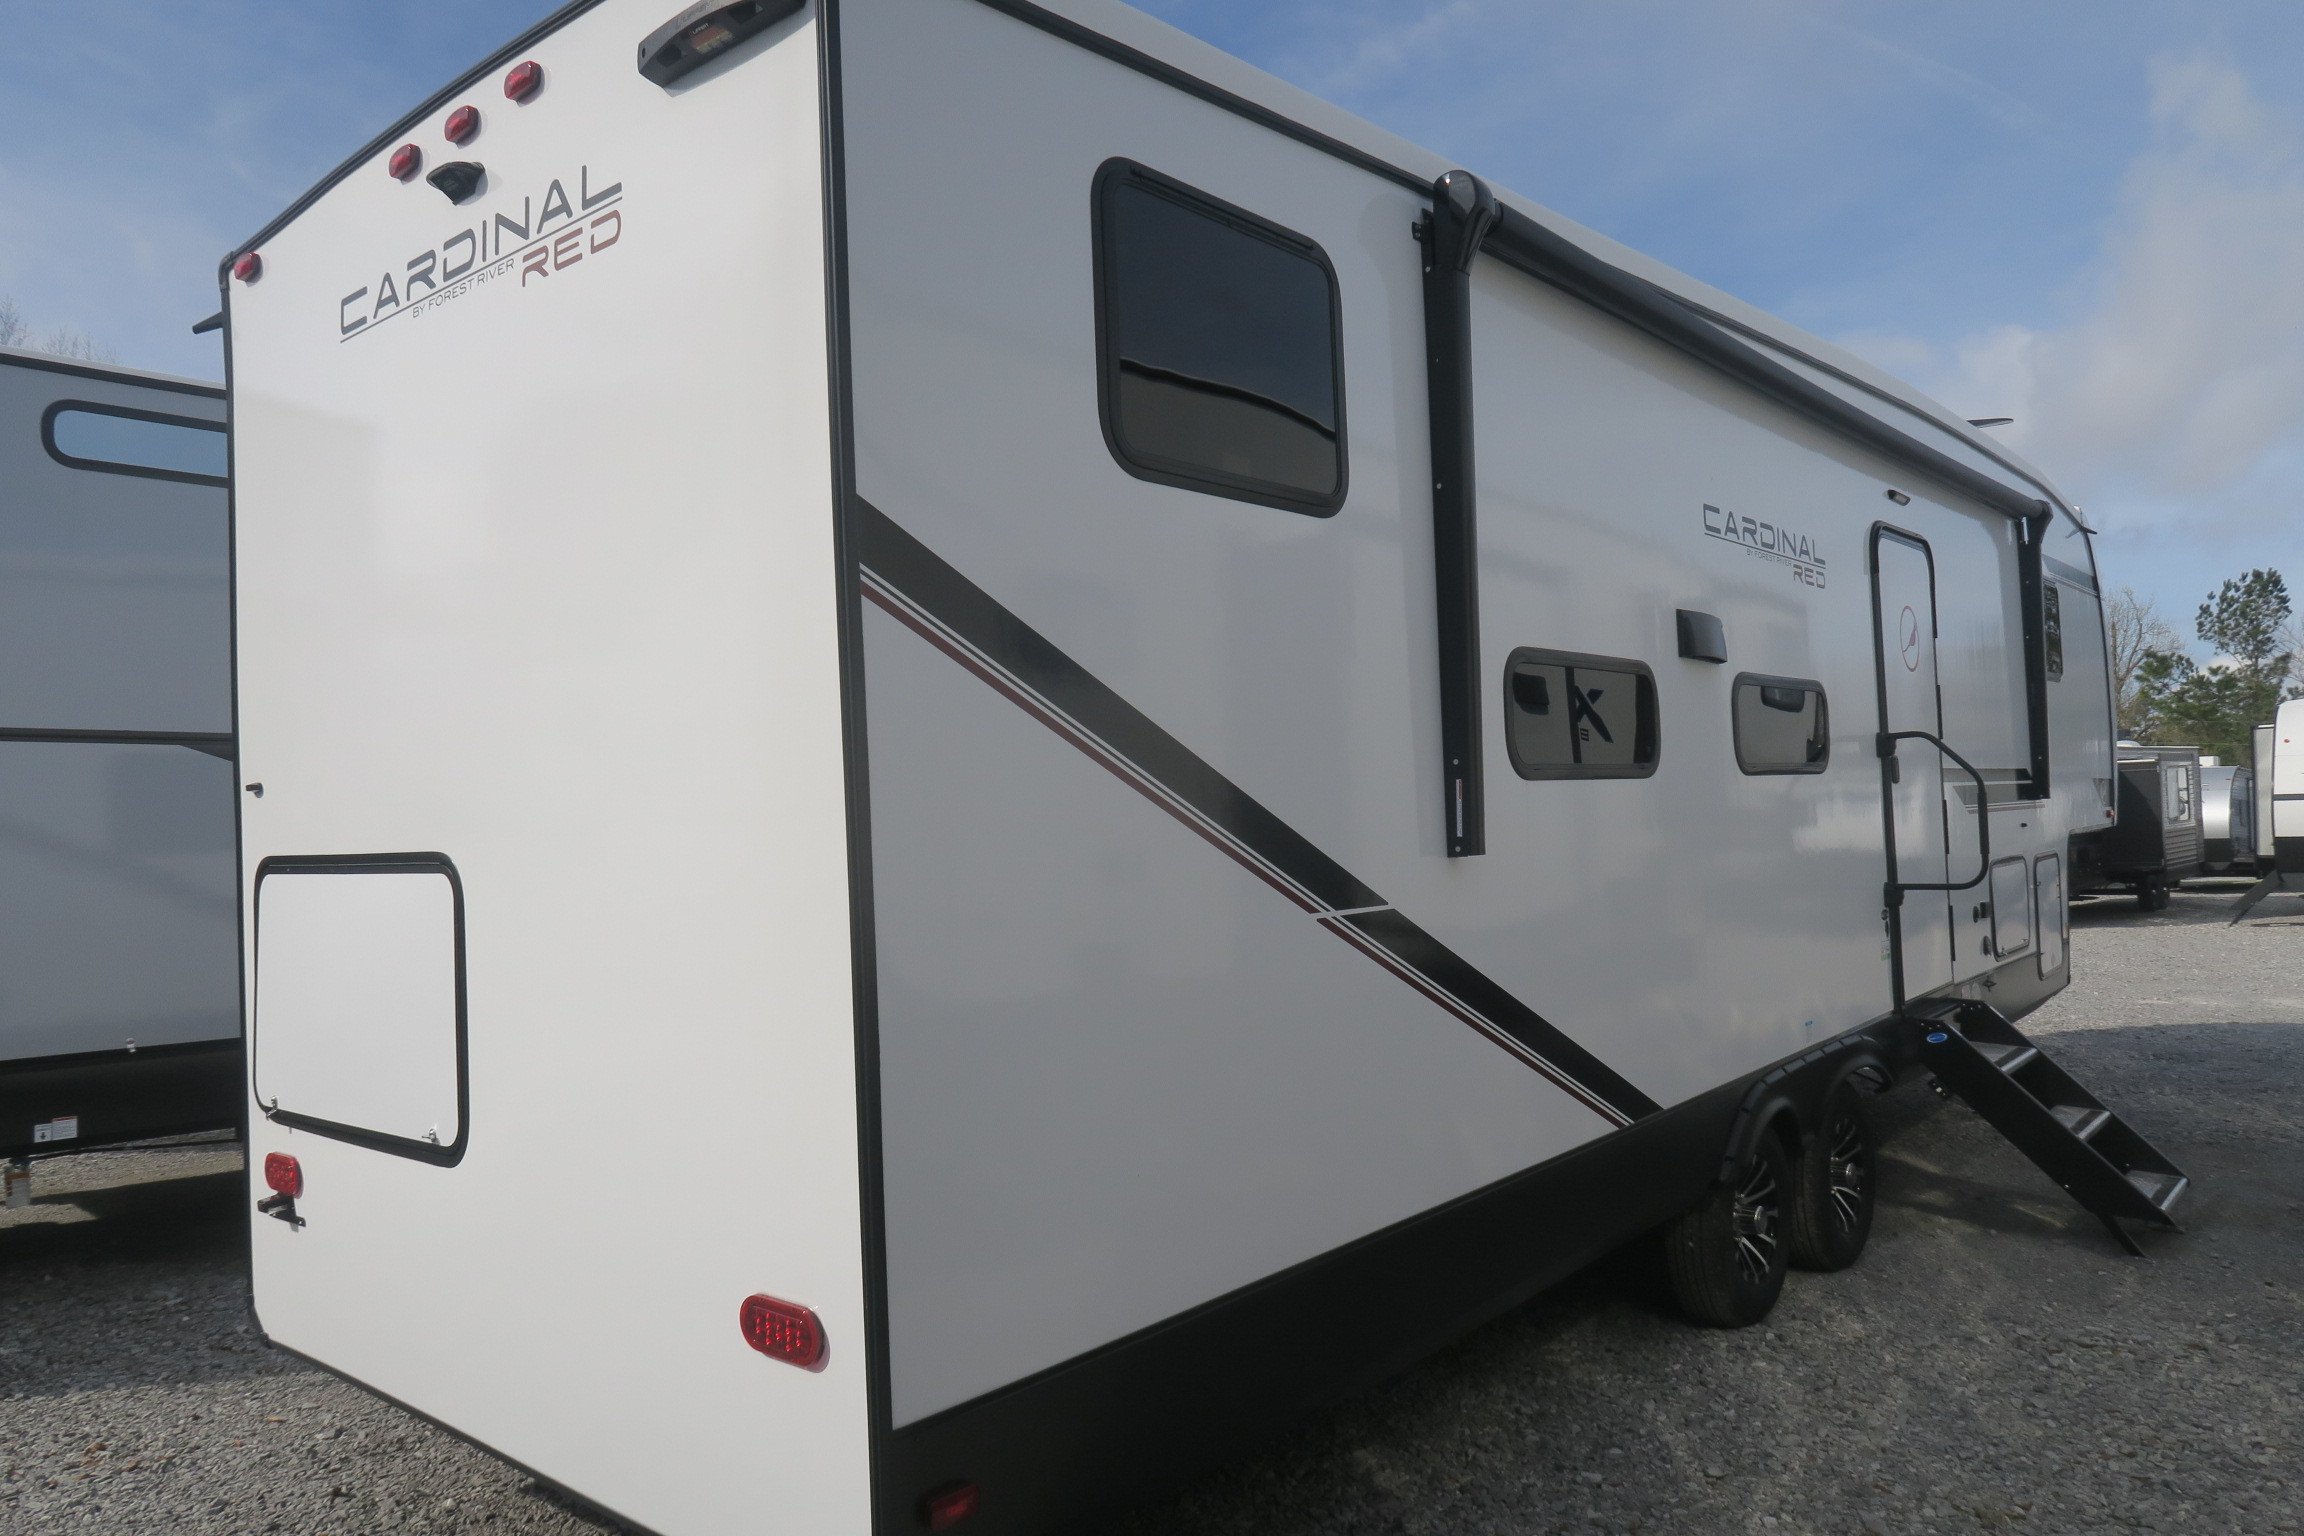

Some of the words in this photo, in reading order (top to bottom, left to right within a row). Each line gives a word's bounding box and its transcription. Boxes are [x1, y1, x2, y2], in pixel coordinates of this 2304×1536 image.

[340, 164, 623, 335] CARDINAL
[522, 209, 622, 287] RED
[412, 304, 426, 318] BY
[428, 277, 475, 310] FOREST
[477, 258, 515, 287] RIVER
[1702, 503, 1826, 565] CARDINAL
[1792, 563, 1826, 590] RED
